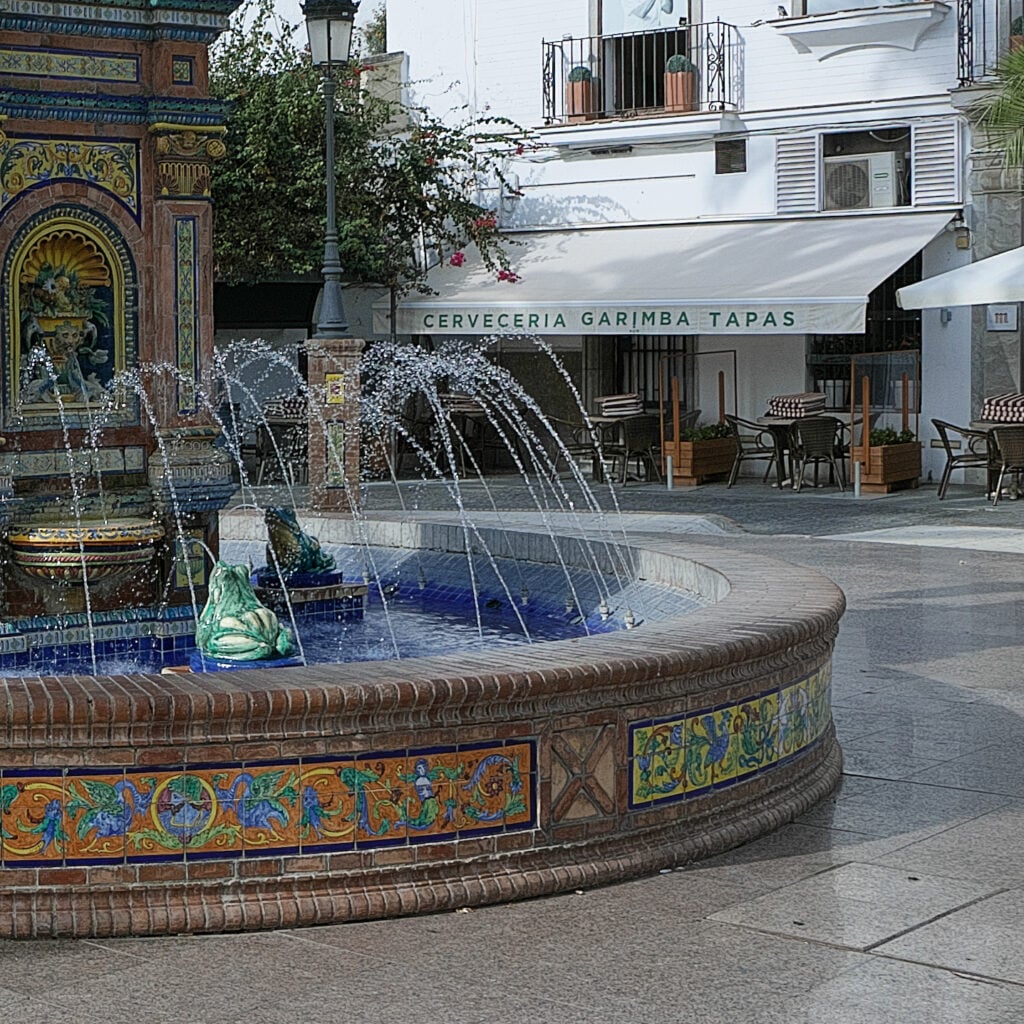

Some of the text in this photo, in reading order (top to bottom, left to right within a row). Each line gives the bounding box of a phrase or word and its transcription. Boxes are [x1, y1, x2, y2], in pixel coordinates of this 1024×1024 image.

[423, 311, 795, 328] CERVECERIA GARIMBA TAPAS
